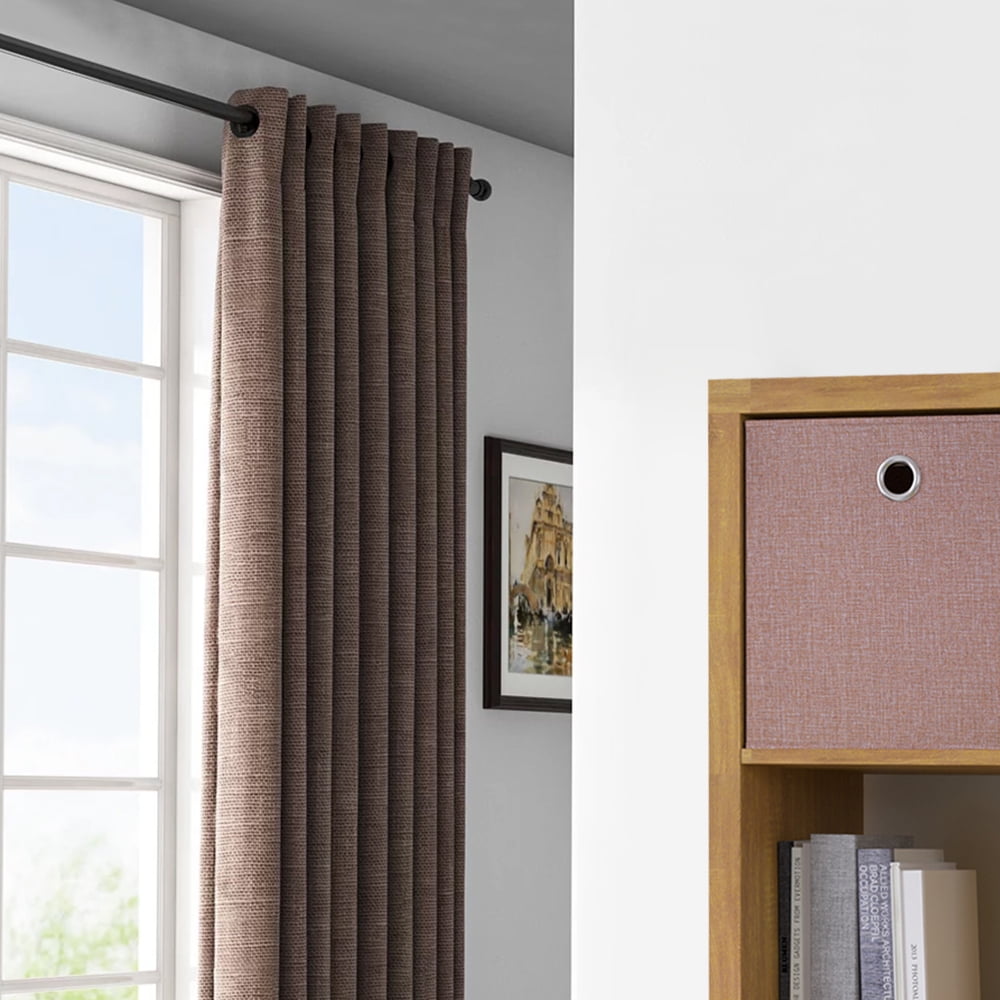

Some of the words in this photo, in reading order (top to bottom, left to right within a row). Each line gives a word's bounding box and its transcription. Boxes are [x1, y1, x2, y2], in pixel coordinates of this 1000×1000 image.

[869, 864, 879, 893] BRAD
[879, 864, 889, 899] ALLIED
[859, 864, 870, 930] OCCUPATION
[793, 905, 801, 923] FROM
[879, 900, 890, 937] WORKS
[793, 927, 801, 960] GADGETS
[793, 962, 801, 990] DESIGN
